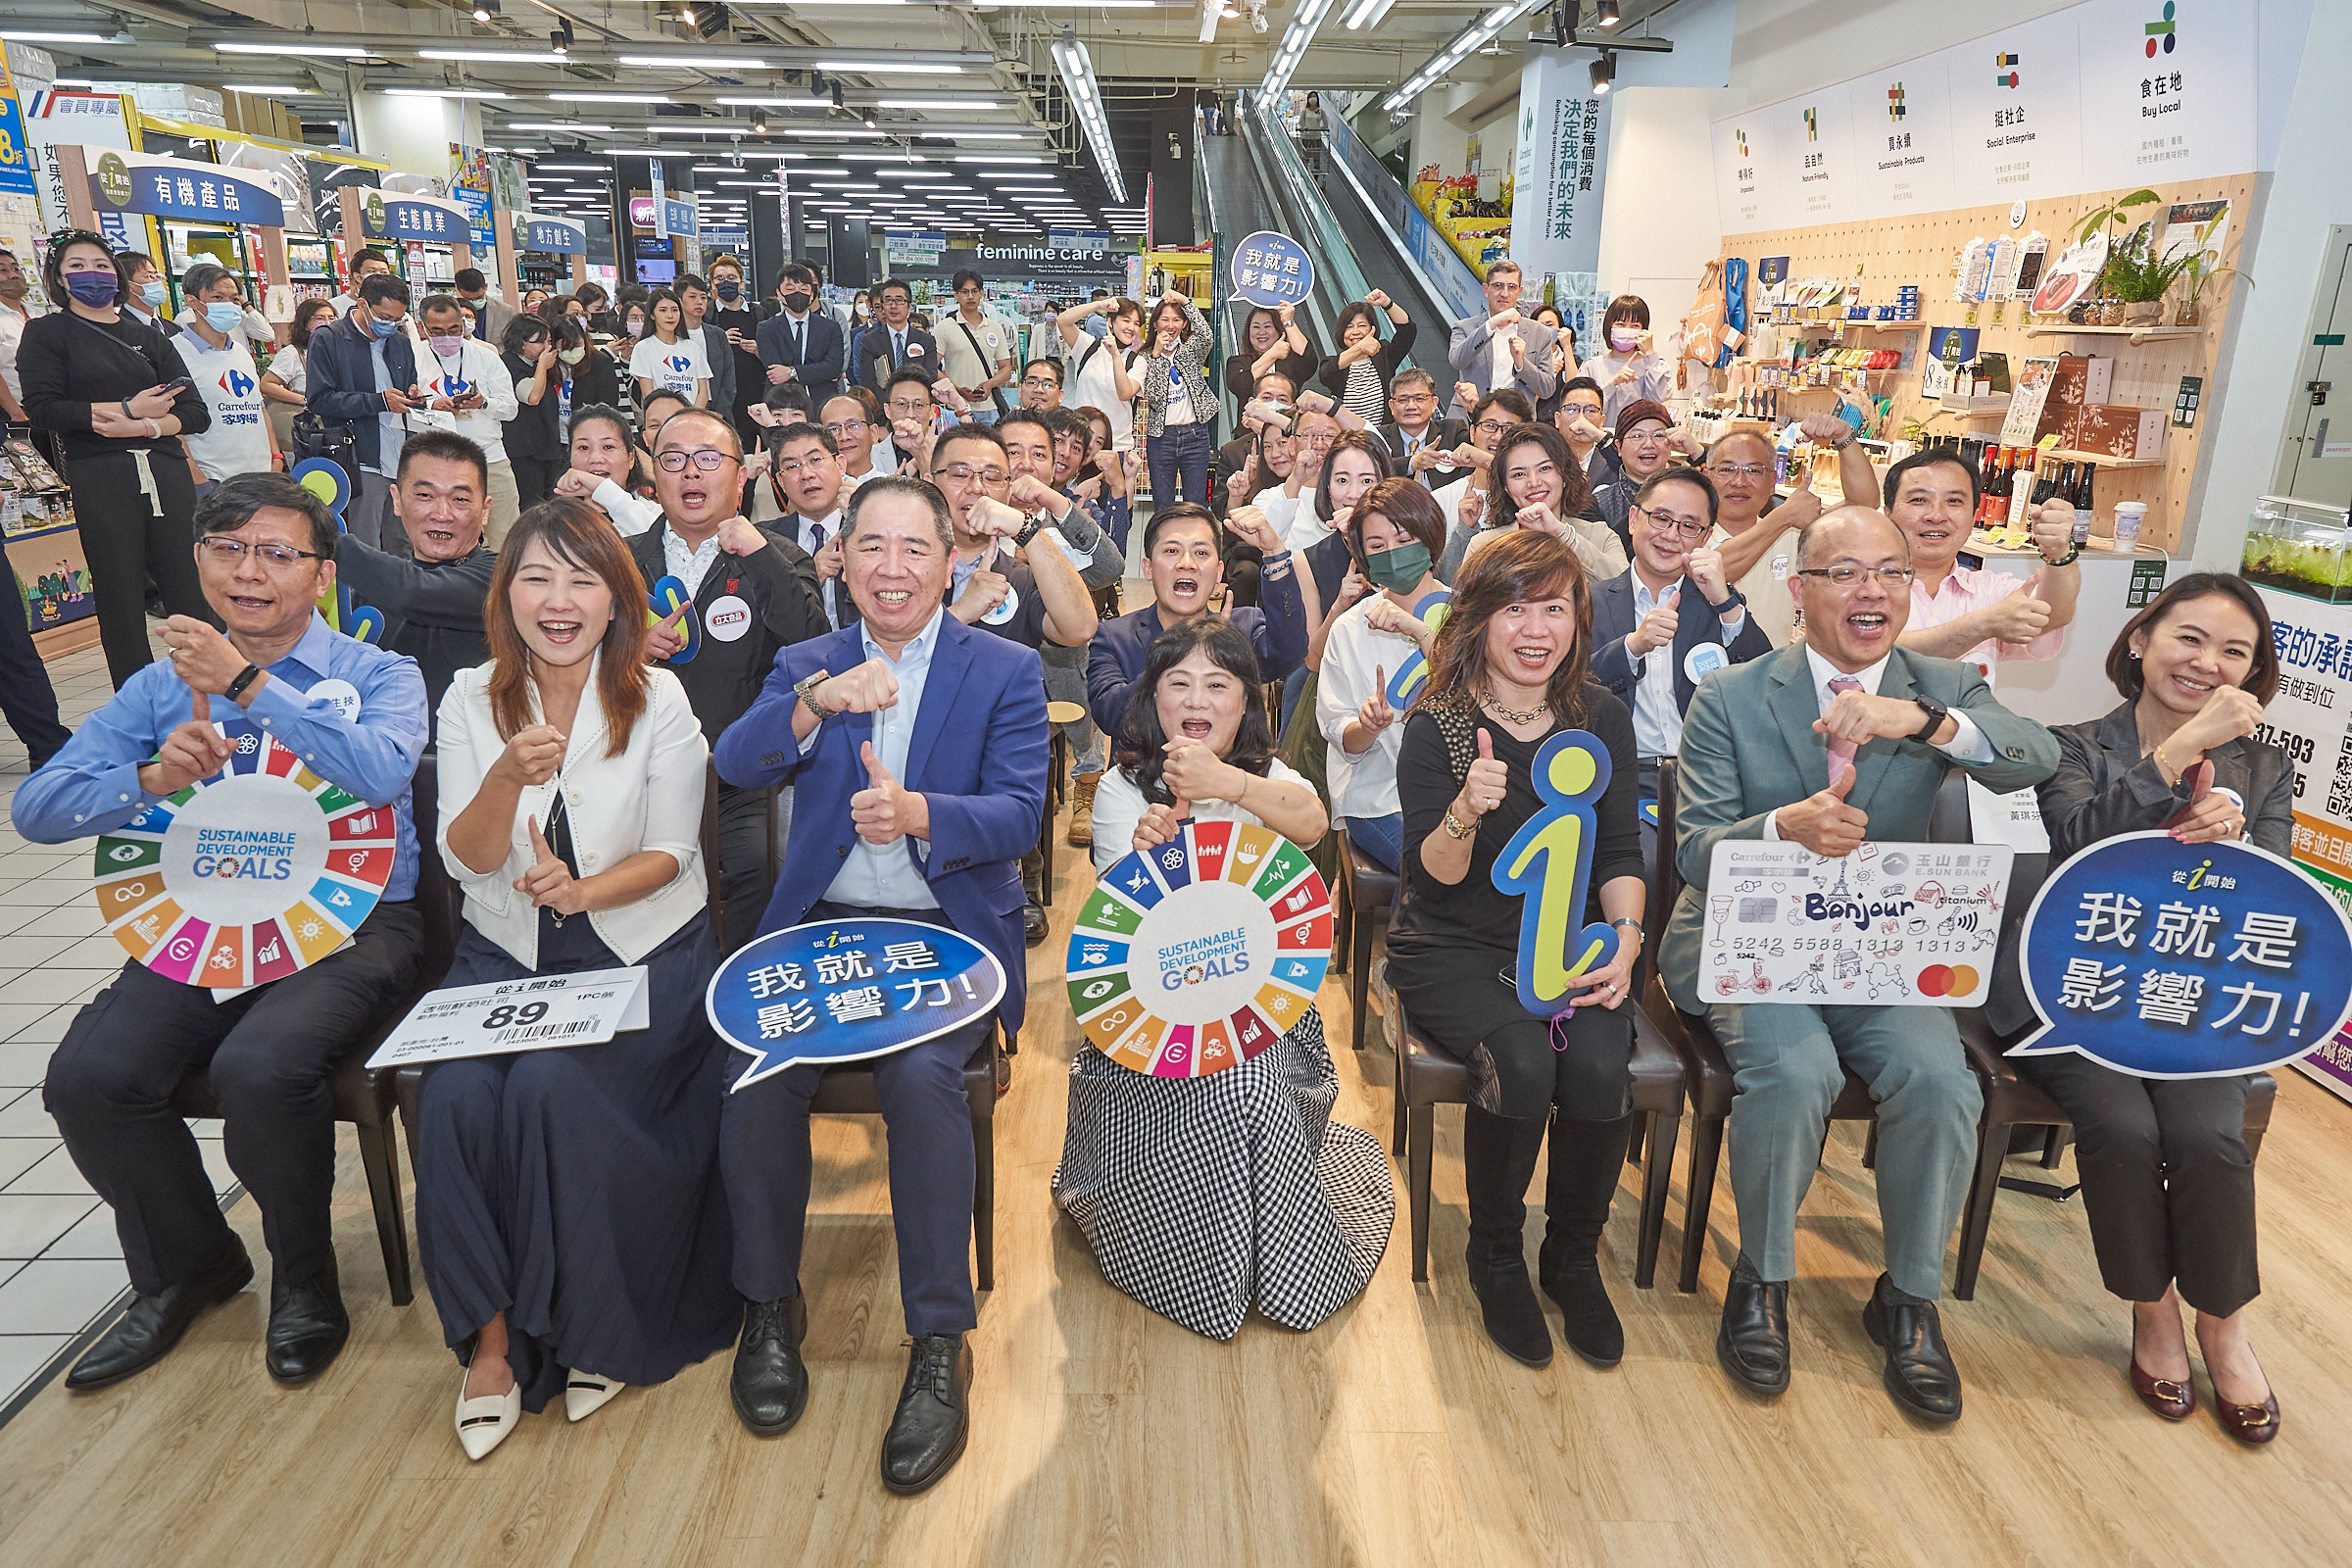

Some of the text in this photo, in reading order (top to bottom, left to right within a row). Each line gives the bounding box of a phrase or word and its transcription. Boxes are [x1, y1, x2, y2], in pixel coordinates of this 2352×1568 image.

[2140, 71, 2182, 99] 食在地
[60, 99, 120, 116] 會員專屬
[1551, 99, 1561, 135] Rethinking
[1994, 106, 2025, 128] 挺社企
[2142, 99, 2181, 119] Buy Local
[1579, 98, 1599, 192] 您的每個消費
[1887, 132, 1912, 152] 買永續
[1986, 131, 2036, 149] Social Enterprise
[1554, 98, 1582, 240] 決定我們的未來
[1804, 152, 1824, 169] 品自然
[1878, 155, 1926, 171] Sustainable Products
[154, 174, 241, 212] 有機產品
[398, 207, 446, 233] 生態農業
[536, 225, 571, 246] 地方創生
[976, 243, 1103, 262] feminine care
[1246, 248, 1300, 275] 我就是
[1240, 269, 1303, 296] 影響力!
[218, 401, 261, 412] Carrefour
[331, 696, 355, 709] 生技
[198, 829, 297, 845] SUSTAINABLE
[196, 843, 294, 857] DEVELOPMENT
[1731, 852, 1785, 862] Carrefour
[1915, 854, 1992, 867] 玉山銀行
[192, 856, 292, 880] GOALS
[1915, 867, 1988, 877] E.SUN BANK
[2172, 860, 2236, 891] 從i開始
[1805, 892, 1914, 931] Bonjour
[1939, 896, 1987, 906] titanium
[812, 930, 865, 950] 從i開始
[2074, 892, 2297, 968] 我就是
[1157, 927, 1247, 959] SUSTAINABLE
[1733, 937, 1783, 951] 5242
[1854, 938, 1903, 951] 1313
[1916, 939, 1965, 953] 1313
[1159, 940, 1247, 971] DEVELOPMENT
[747, 940, 940, 1000] 我就是
[1161, 952, 1250, 991] GOALS
[495, 979, 566, 995] 從i開始
[576, 991, 614, 1000] 1PC個
[2057, 956, 2311, 1038] 影響力!
[482, 1002, 549, 1029] 89
[757, 973, 977, 1040] 影響力!
